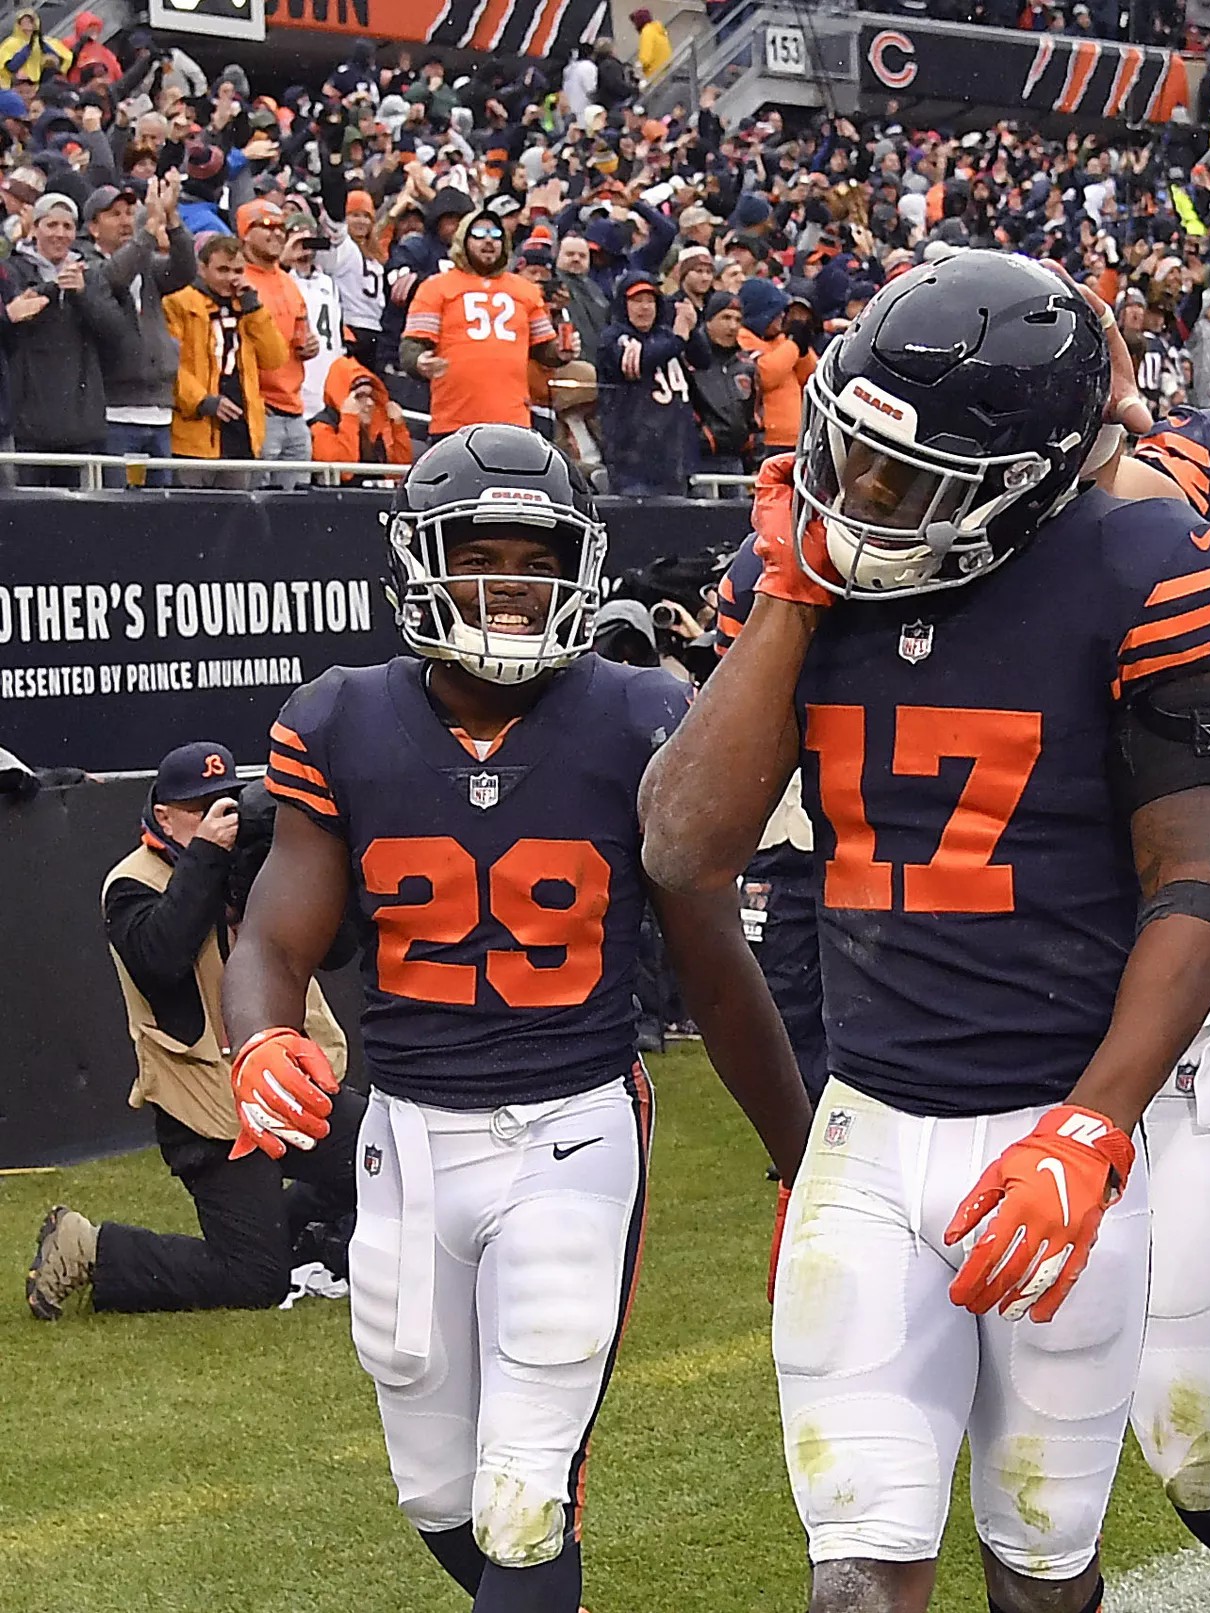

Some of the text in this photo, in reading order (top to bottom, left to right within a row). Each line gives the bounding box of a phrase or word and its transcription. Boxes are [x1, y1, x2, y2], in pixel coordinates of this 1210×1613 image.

[868, 30, 918, 88] C
[463, 291, 517, 342] 52
[156, 580, 371, 637] FOUNDATION
[100, 664, 122, 694] BY
[127, 661, 193, 692] PRINCE
[202, 754, 225, 778] B
[805, 703, 1042, 912] 17
[361, 836, 611, 1008] 29
